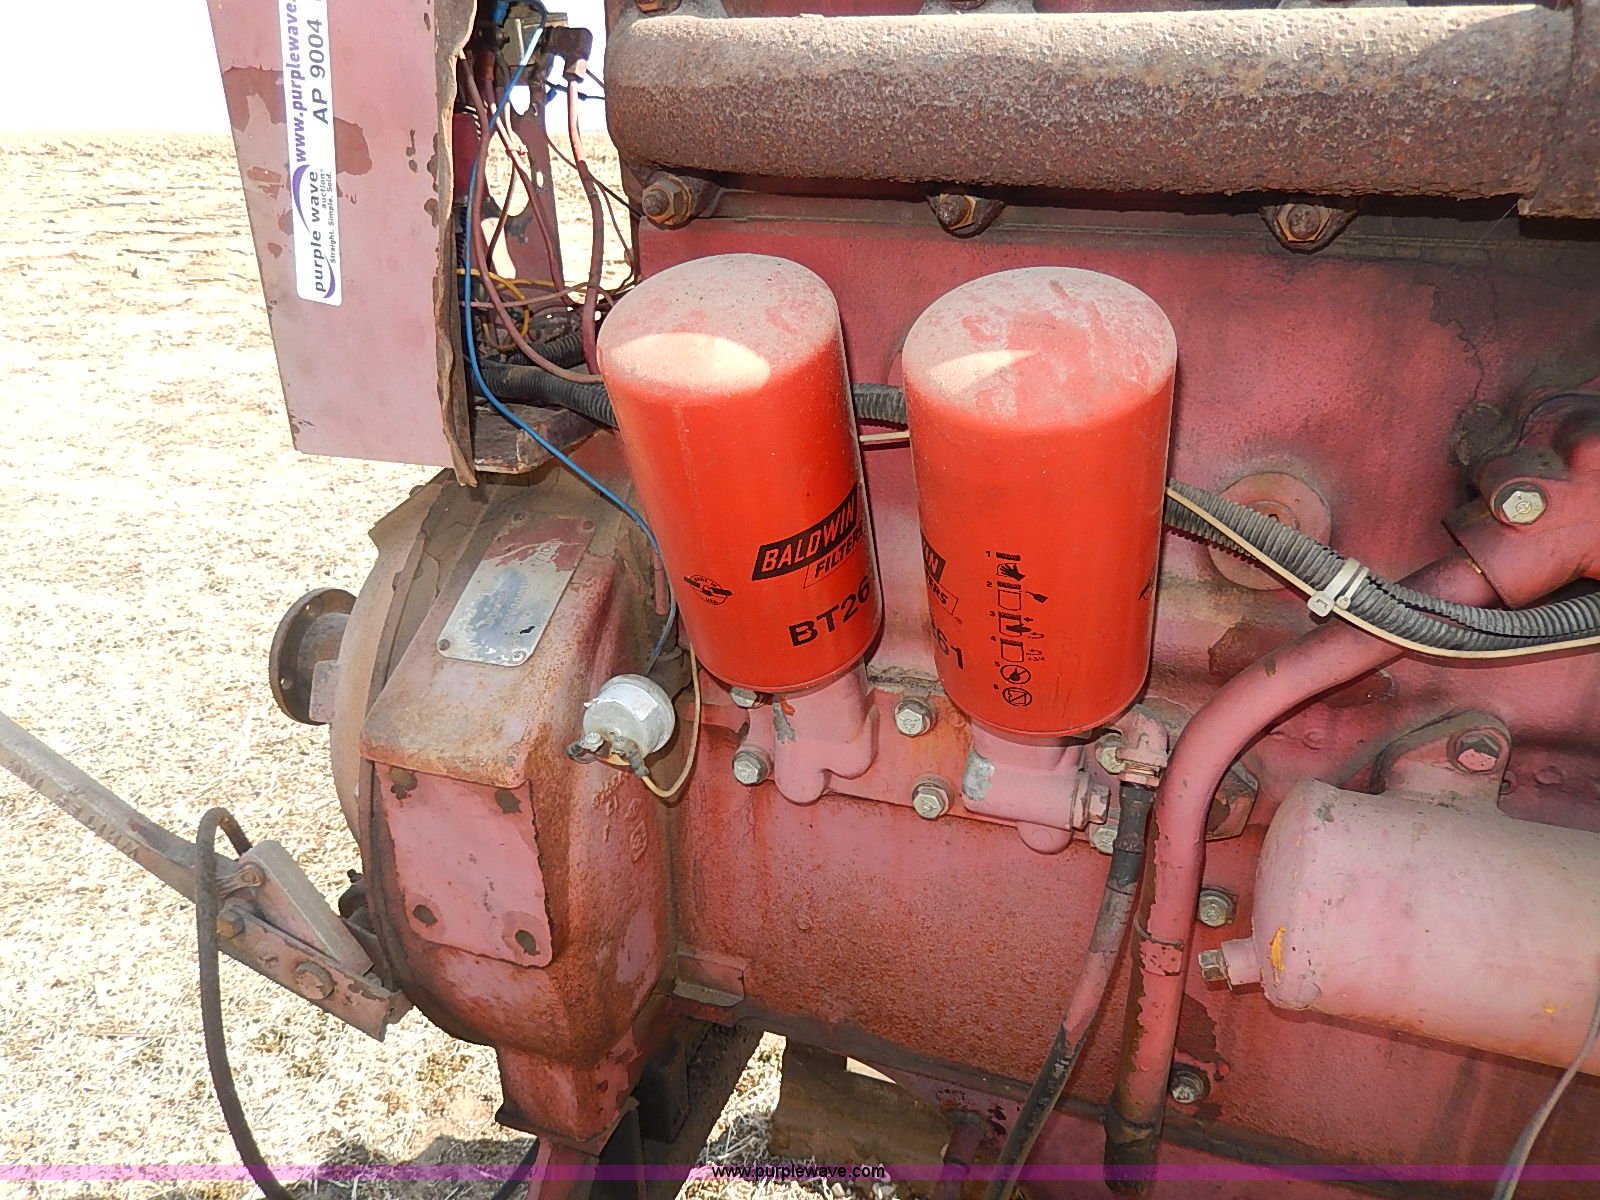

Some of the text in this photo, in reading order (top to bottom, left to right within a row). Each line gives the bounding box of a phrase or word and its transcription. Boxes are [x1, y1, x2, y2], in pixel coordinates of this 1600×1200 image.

[307, 19, 329, 125] AP 9004
[309, 171, 327, 292] purple wave
[761, 494, 854, 572] BALDWIN
